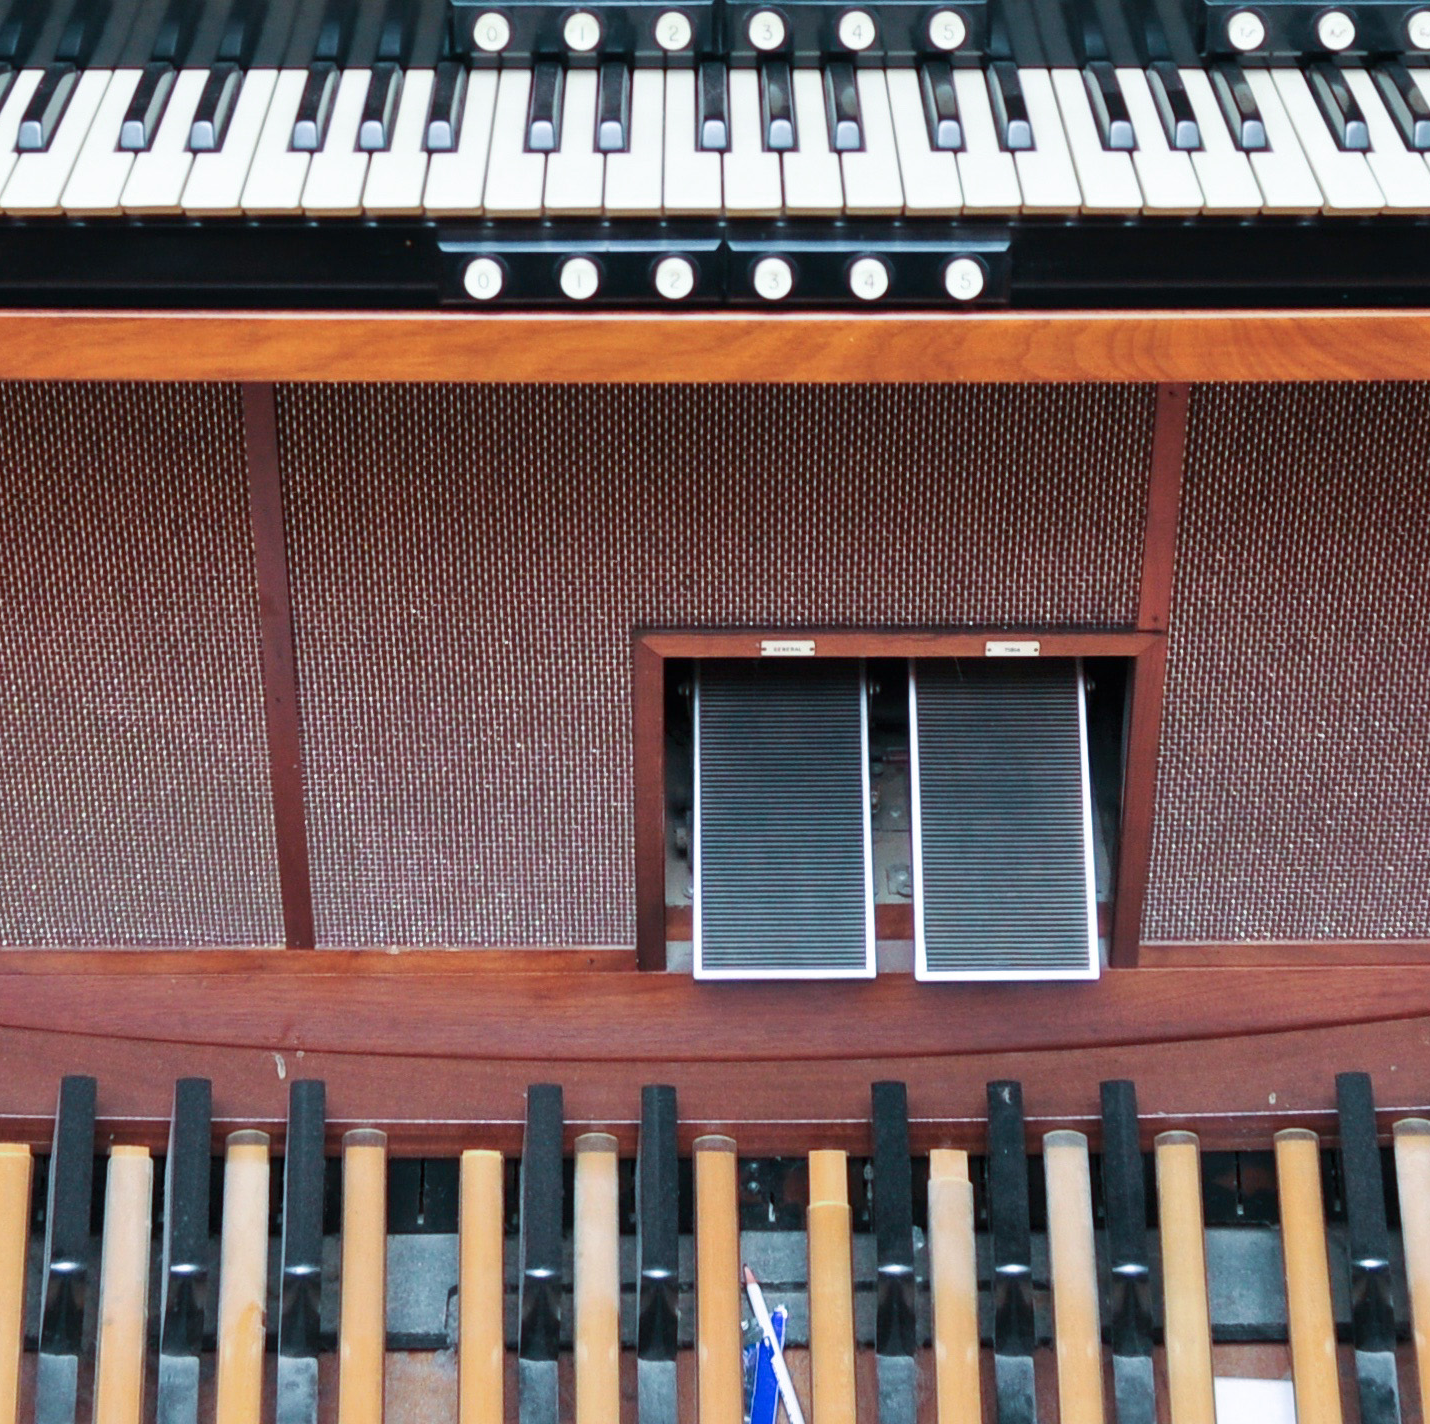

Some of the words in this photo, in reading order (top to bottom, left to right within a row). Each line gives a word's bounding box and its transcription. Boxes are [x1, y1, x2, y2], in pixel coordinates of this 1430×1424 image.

[669, 26, 679, 41] 2
[763, 24, 772, 40] 3
[853, 25, 862, 39] 4
[944, 24, 954, 40] 5
[670, 273, 680, 288] 2
[769, 274, 779, 289] 3
[865, 274, 874, 289] 4
[960, 273, 971, 289] 5
